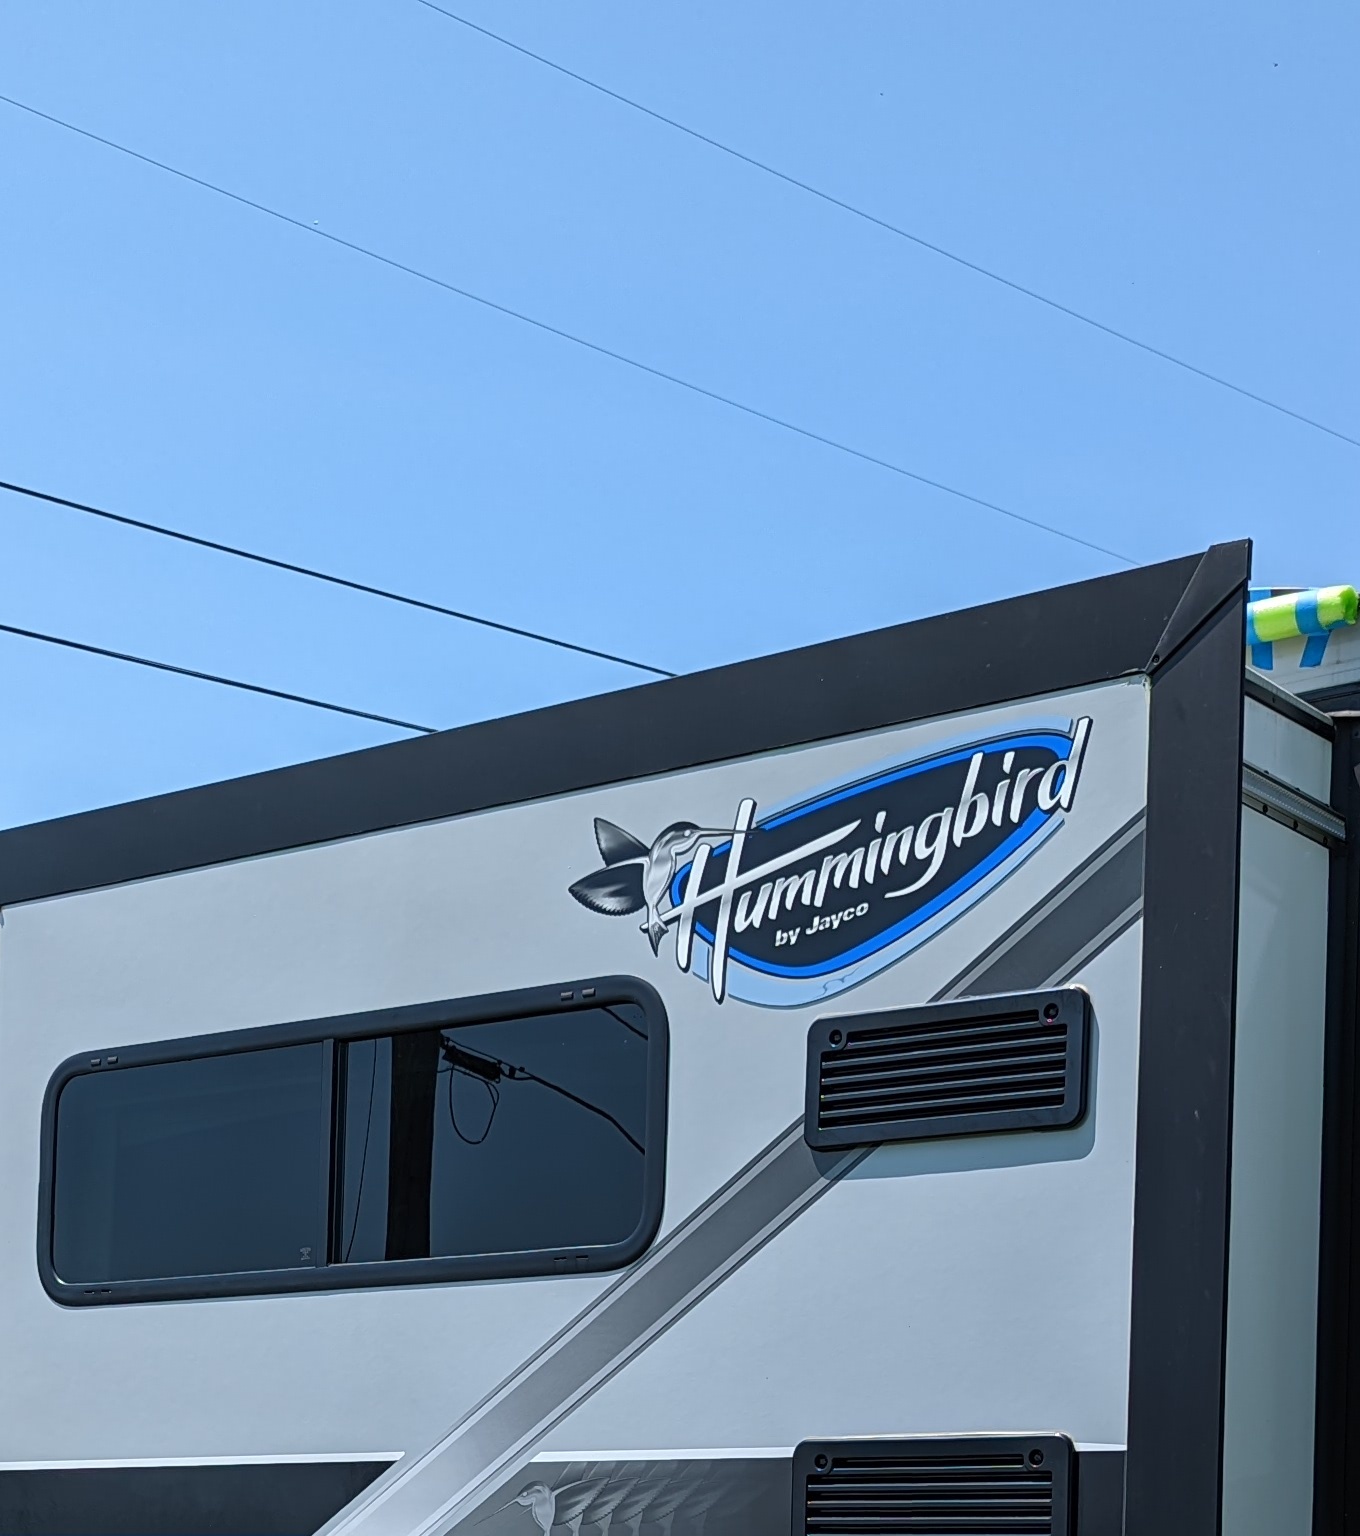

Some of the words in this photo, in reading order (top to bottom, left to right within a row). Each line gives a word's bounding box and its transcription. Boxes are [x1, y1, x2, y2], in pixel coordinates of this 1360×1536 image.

[639, 716, 1093, 1004] Hummingbird
[774, 926, 801, 947] by
[805, 902, 870, 935] Jayco
